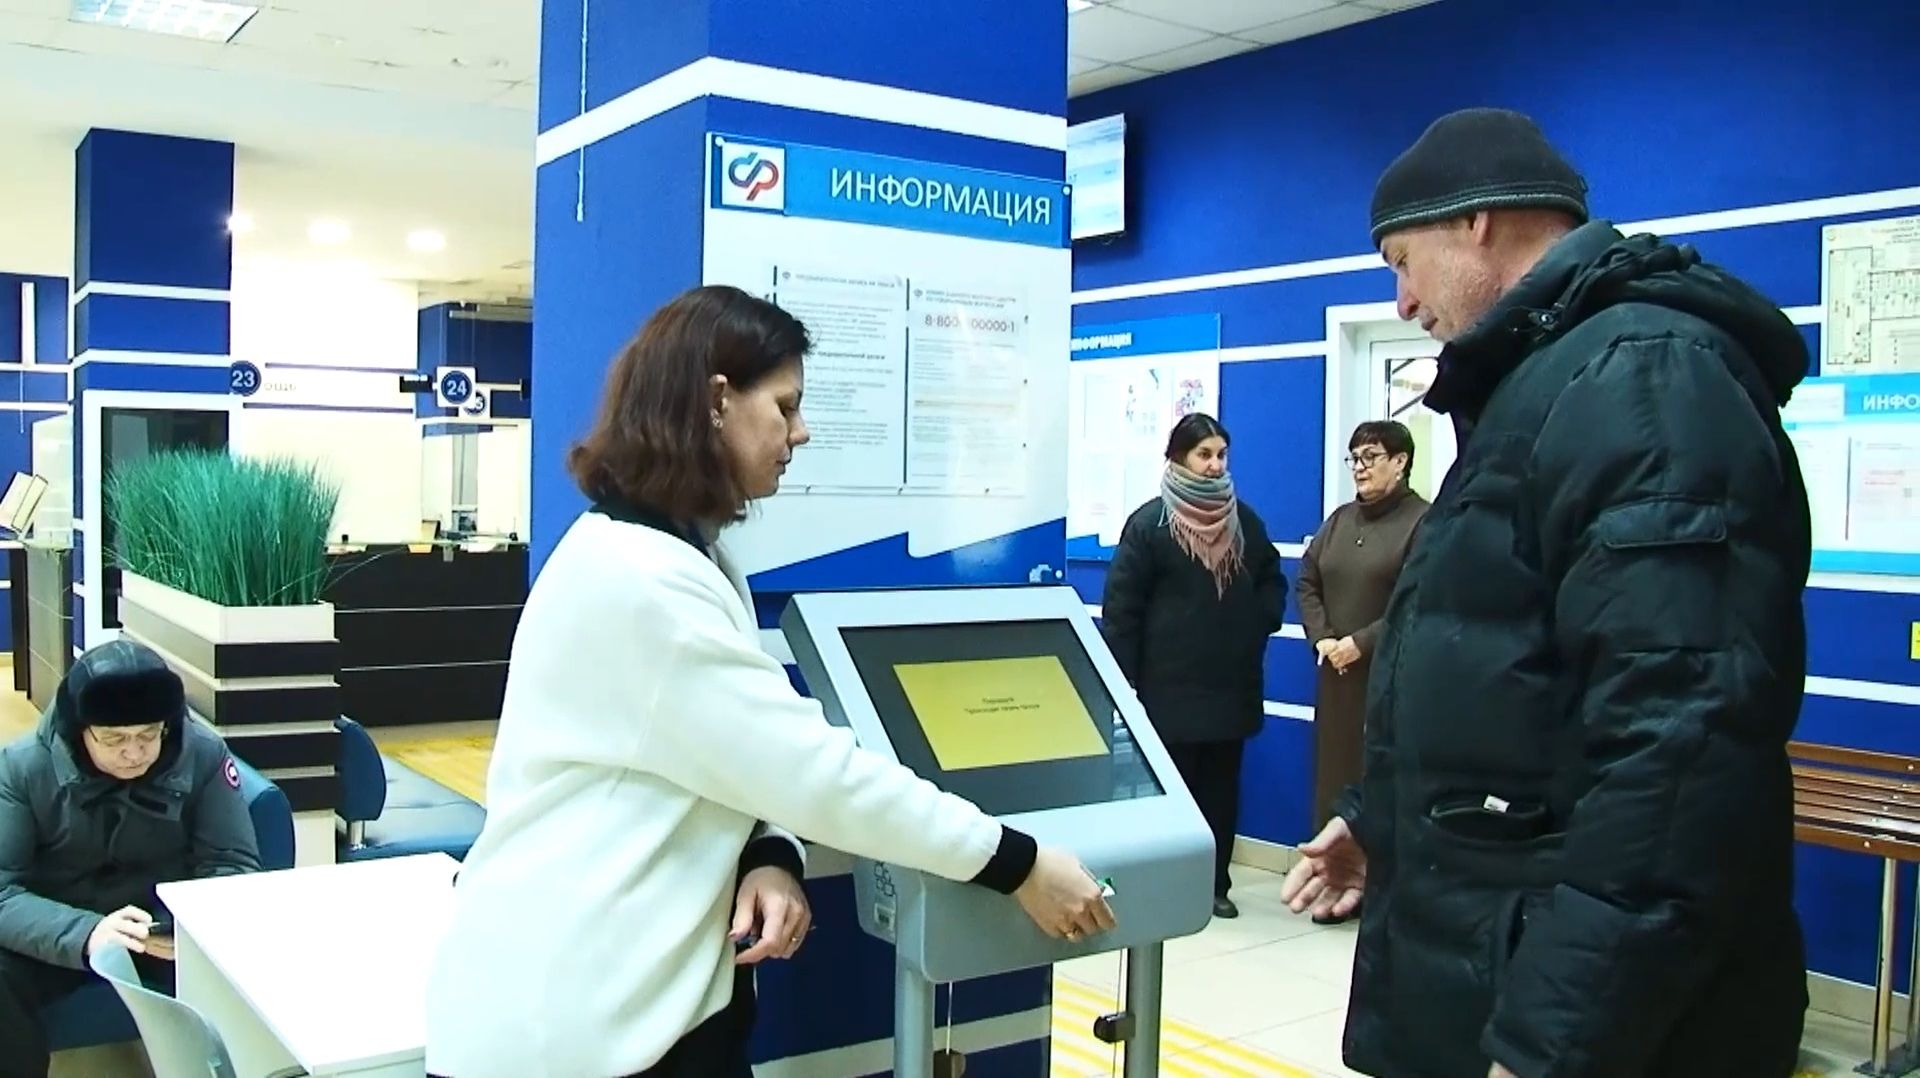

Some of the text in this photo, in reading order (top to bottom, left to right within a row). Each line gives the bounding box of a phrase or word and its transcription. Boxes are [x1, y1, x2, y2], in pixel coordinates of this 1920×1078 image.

[831, 167, 1050, 226] ИНФОРМАЦИЯ
[231, 370, 255, 388] 23
[447, 380, 467, 396] 24
[1863, 393, 1920, 411] ИНФО
